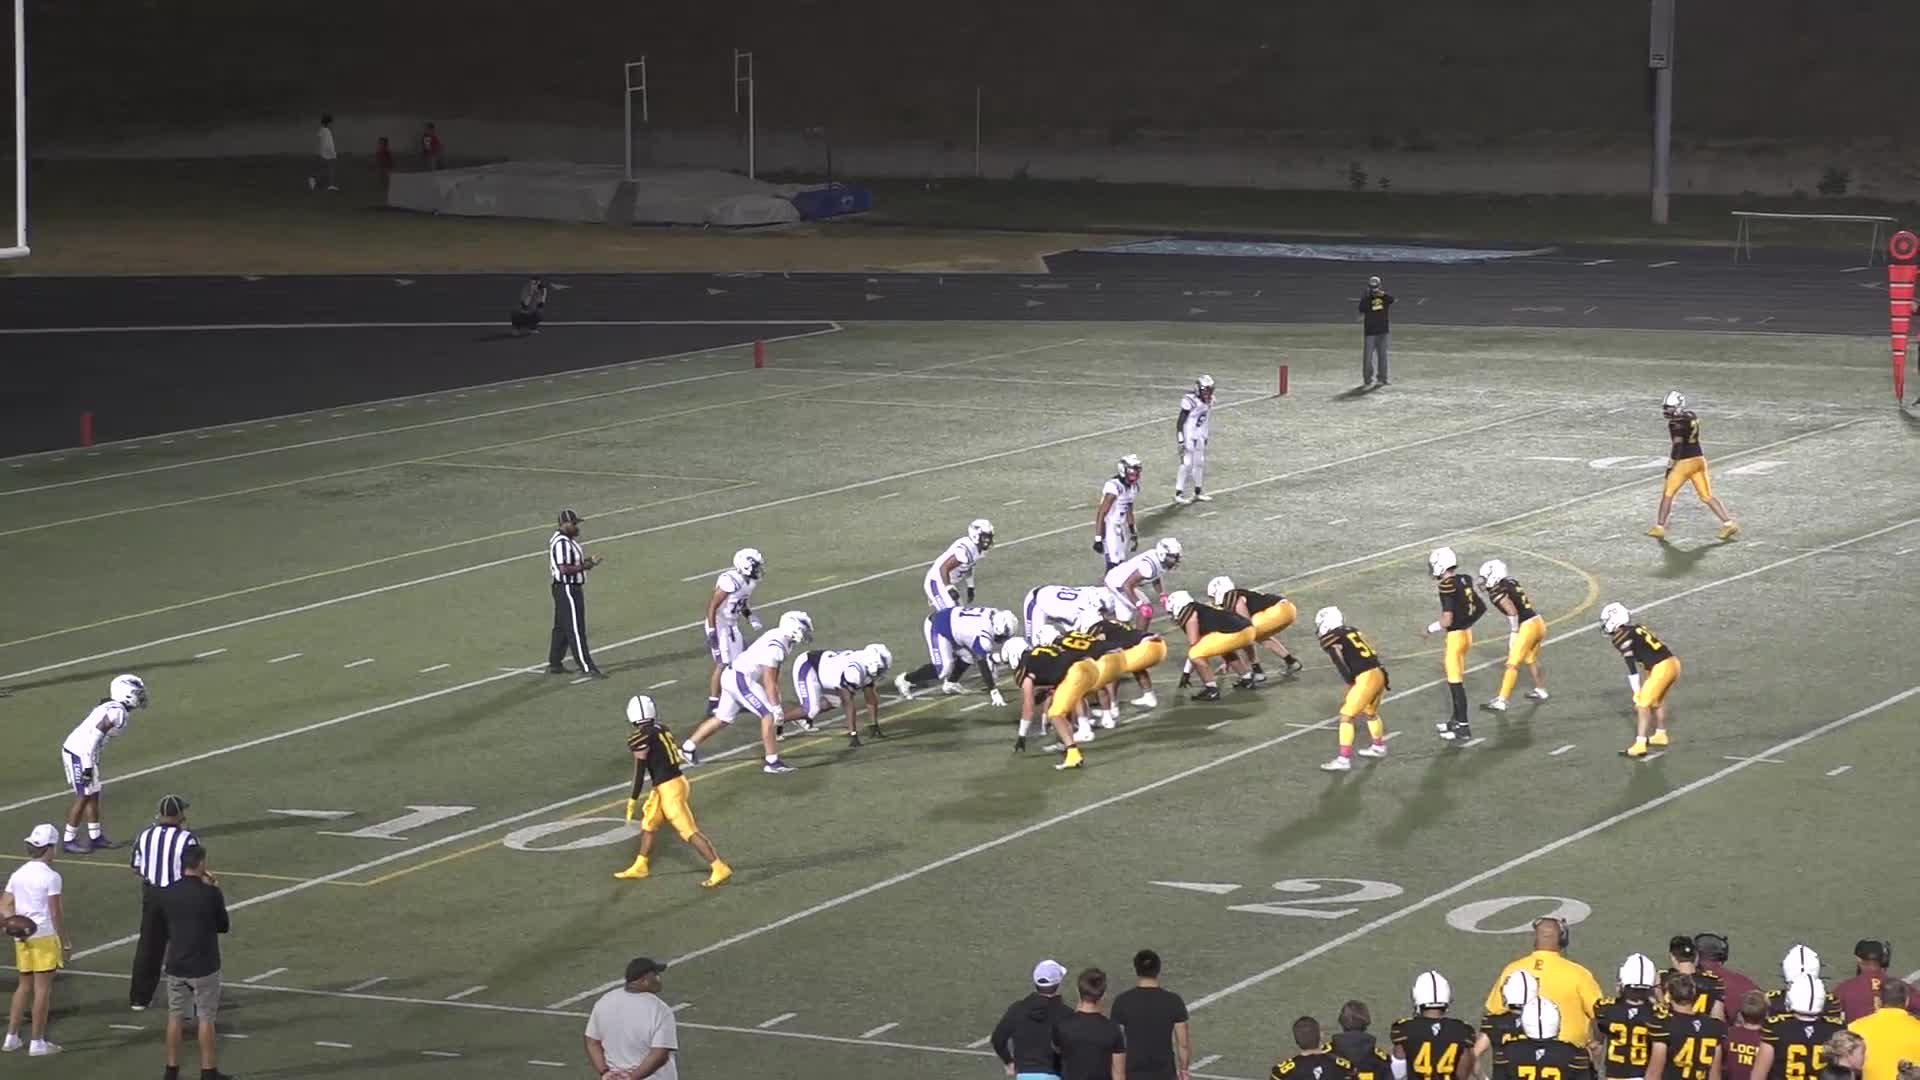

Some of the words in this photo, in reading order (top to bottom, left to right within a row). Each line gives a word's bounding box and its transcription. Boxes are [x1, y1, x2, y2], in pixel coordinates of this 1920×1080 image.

[1413, 1041, 1459, 1080] 44
[1607, 1022, 1649, 1066] 28
[1673, 1037, 1719, 1080] 45
[1738, 1054, 1753, 1066] IN
